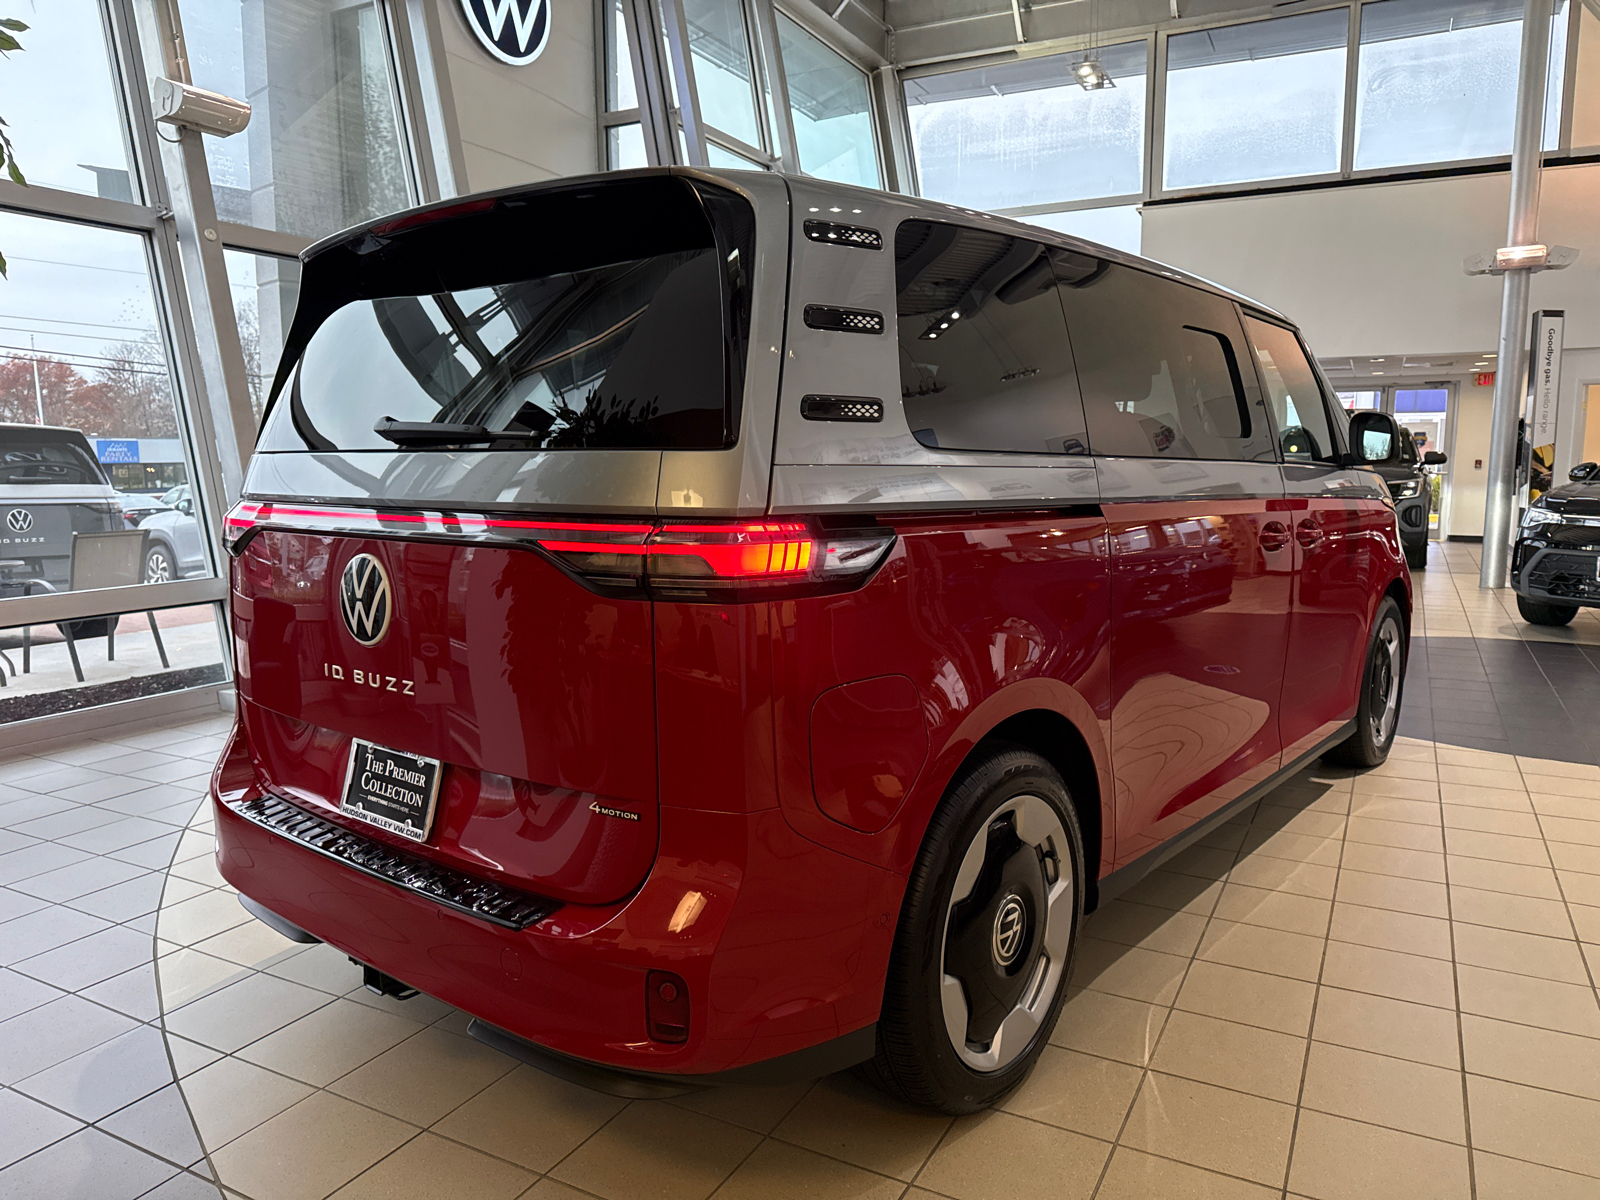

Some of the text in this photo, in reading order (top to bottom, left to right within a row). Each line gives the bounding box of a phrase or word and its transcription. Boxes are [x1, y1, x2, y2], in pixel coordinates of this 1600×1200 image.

[1478, 373, 1495, 386] EXIT
[1541, 328, 1555, 435] Goodbye gas. Hello range.
[340, 554, 391, 643] VW
[353, 669, 415, 696] BUZZ
[365, 753, 426, 788] THE PREMIER
[361, 771, 424, 808] COLLECTION
[342, 806, 422, 840] HUDSON VALLEY VW.COM
